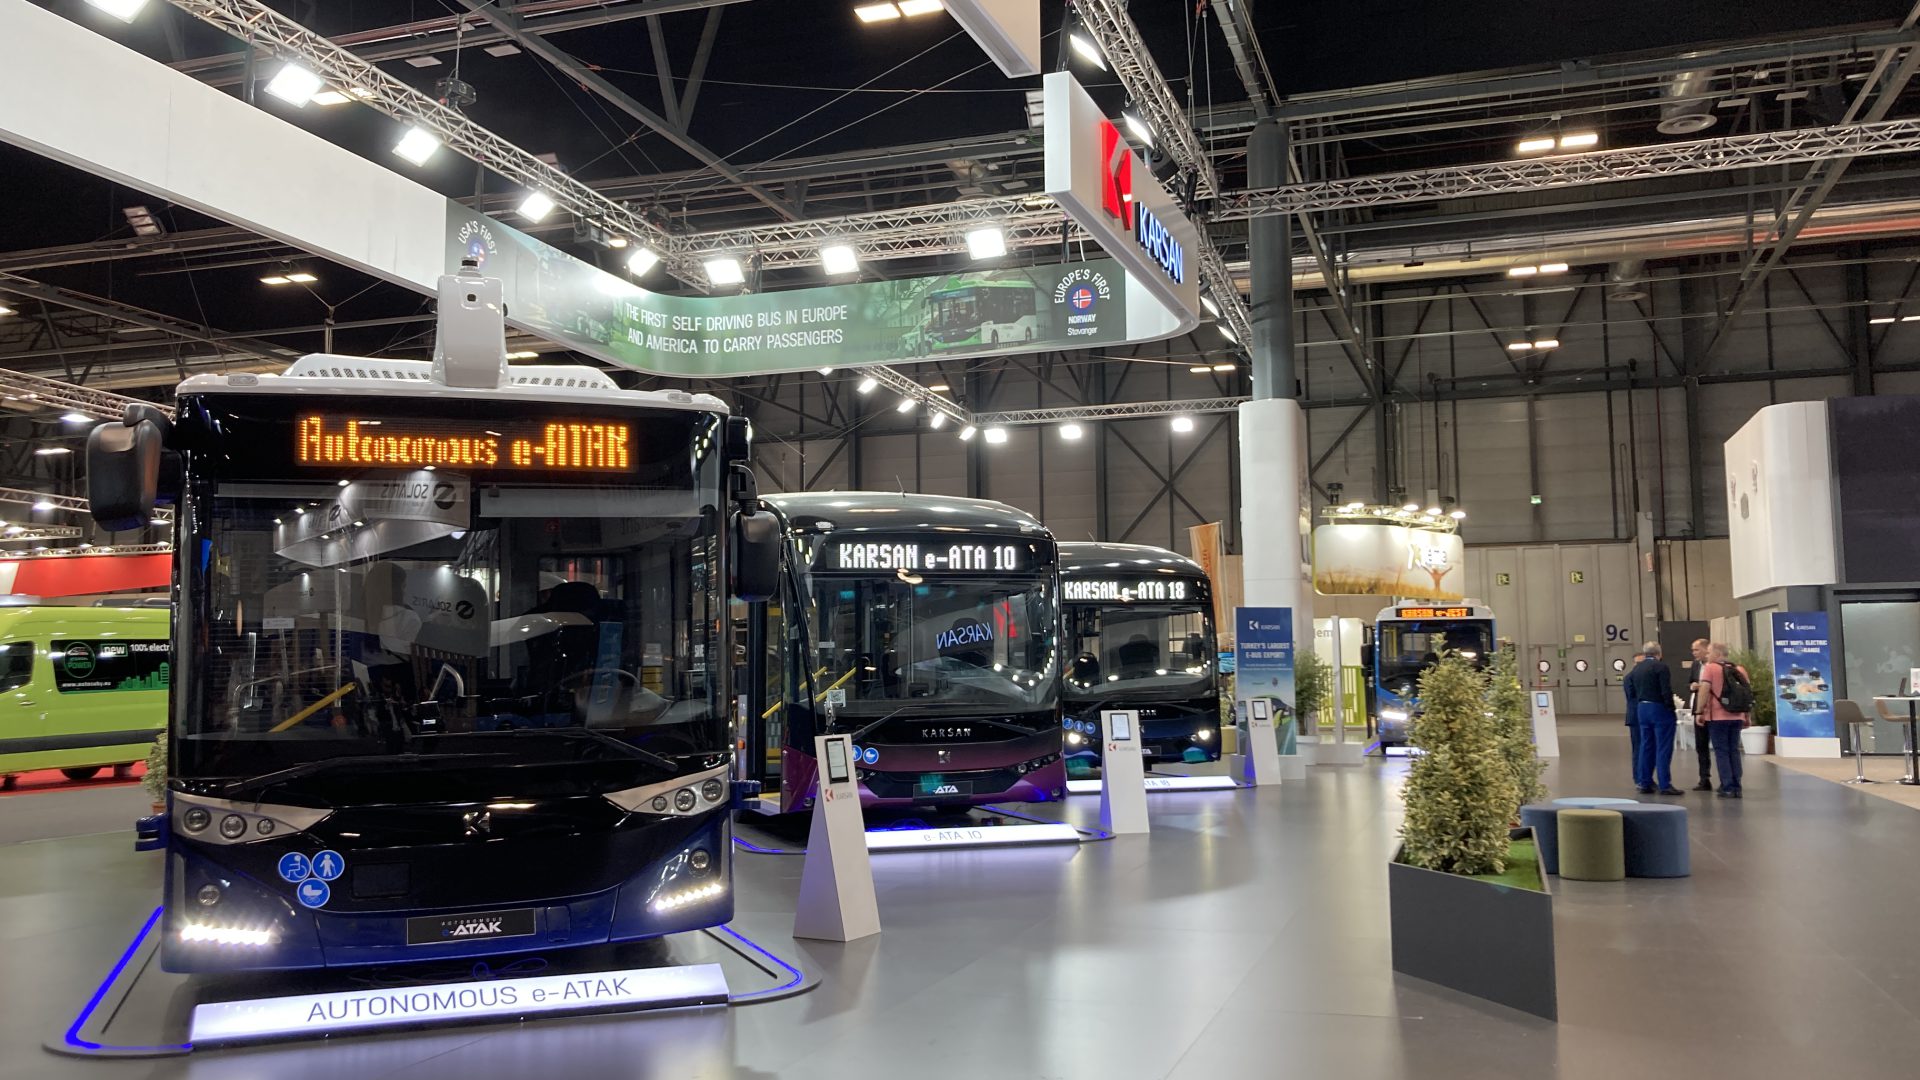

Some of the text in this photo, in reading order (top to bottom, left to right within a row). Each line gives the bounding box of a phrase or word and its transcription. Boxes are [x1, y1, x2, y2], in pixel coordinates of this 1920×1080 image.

[458, 220, 498, 256] USA'S FIRST
[1136, 201, 1184, 284] KARSAN
[1054, 268, 1111, 304] EUROPE'S FIRST
[625, 302, 848, 332] THE FIRST SELF DRIVING BUS IN EUROPE
[1068, 313, 1097, 325] NORWAY
[627, 327, 843, 354] AND AMERICA TO CARRY PASSENGERS
[1067, 326, 1098, 337] Stavanger
[300, 416, 629, 468] Autonomous e-ATAK
[839, 543, 1016, 570] KARSAN e-ATA 10
[1064, 581, 1185, 601] KARSAN e-ATA 18
[1605, 624, 1629, 642] 9c
[130, 644, 148, 652] 100%
[149, 643, 170, 652] electr
[922, 727, 971, 738] KARSAN
[307, 976, 632, 1022] AUTONOMOUS e-ATAK
